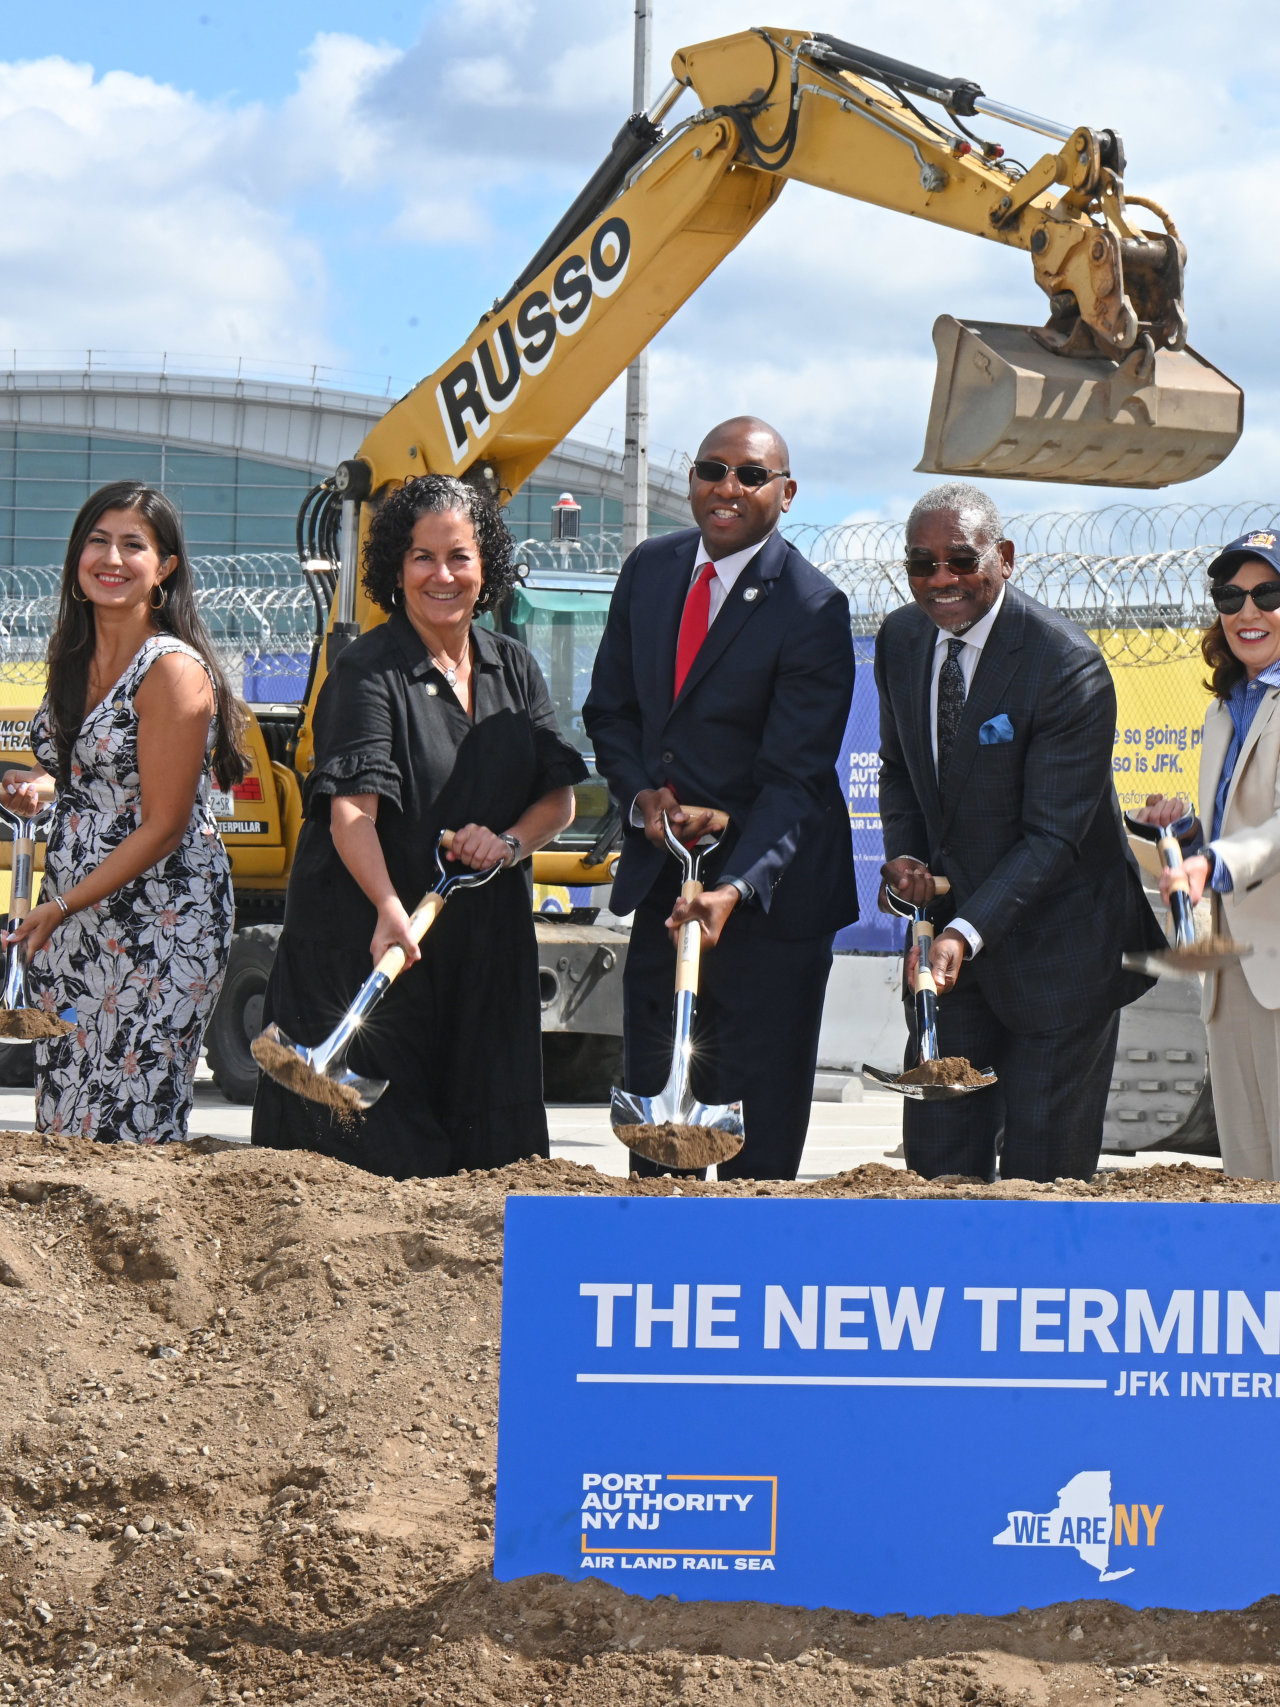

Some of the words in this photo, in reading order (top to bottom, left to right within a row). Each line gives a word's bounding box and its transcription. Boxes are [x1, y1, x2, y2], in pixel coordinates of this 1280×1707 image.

[437, 217, 631, 462] RUSSO
[1124, 729, 1141, 744] so
[1145, 724, 1187, 751] going
[1113, 756, 1131, 772] so
[1135, 752, 1148, 773] is
[1152, 754, 1183, 773] JFK.
[849, 784, 868, 798] NY
[217, 821, 261, 833] TERPILLAR
[580, 1283, 741, 1348] THE
[764, 1285, 944, 1350] NEW
[1114, 1371, 1169, 1397] JFK
[582, 1473, 662, 1491] PORT
[581, 1492, 754, 1511] AUTHORITY
[581, 1512, 623, 1529] NY
[627, 1512, 660, 1530] NJ
[1013, 1516, 1050, 1543] WE
[1059, 1517, 1107, 1544] ARE
[1114, 1504, 1165, 1546] NY
[580, 1556, 615, 1569] AIR
[621, 1557, 677, 1569] LAND
[682, 1557, 729, 1570] RAIL
[734, 1558, 776, 1571] SEA
